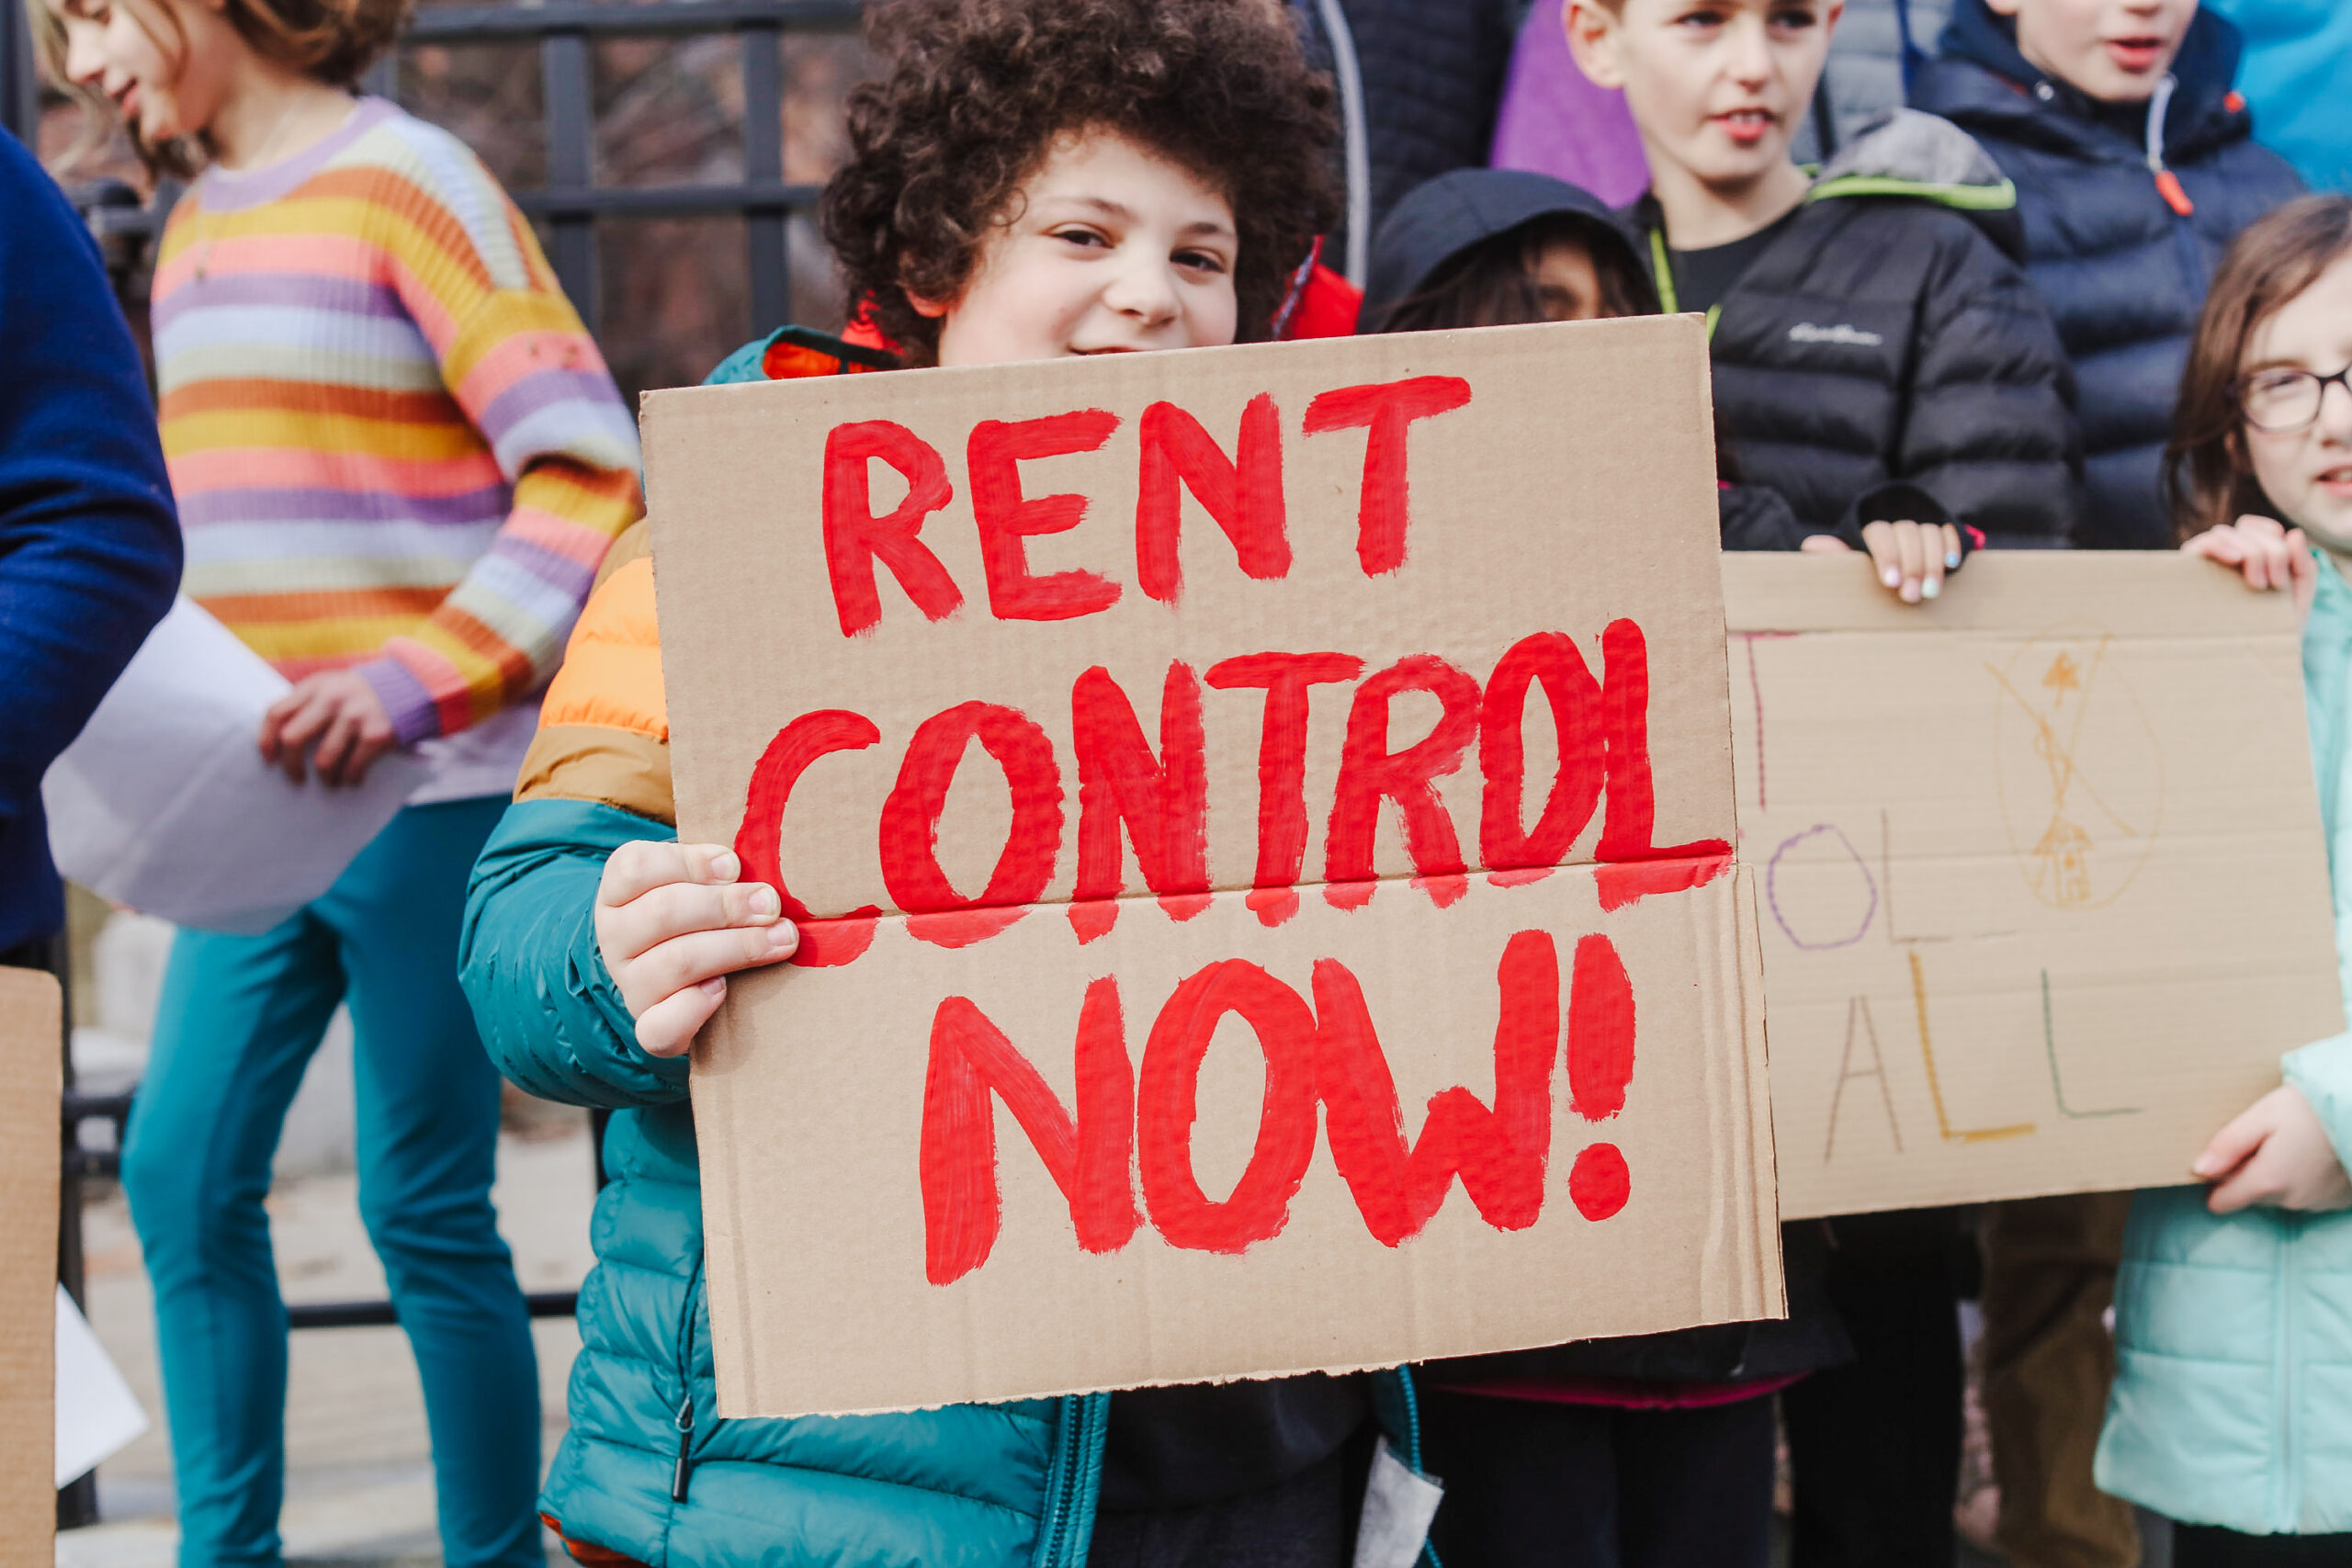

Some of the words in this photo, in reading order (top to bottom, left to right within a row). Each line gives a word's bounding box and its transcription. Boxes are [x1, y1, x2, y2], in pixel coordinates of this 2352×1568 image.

[821, 375, 1472, 638] RENT
[735, 617, 1735, 967] CONTROL
[920, 930, 1636, 1286] NOW!
[1824, 952, 2145, 1165] ALL
